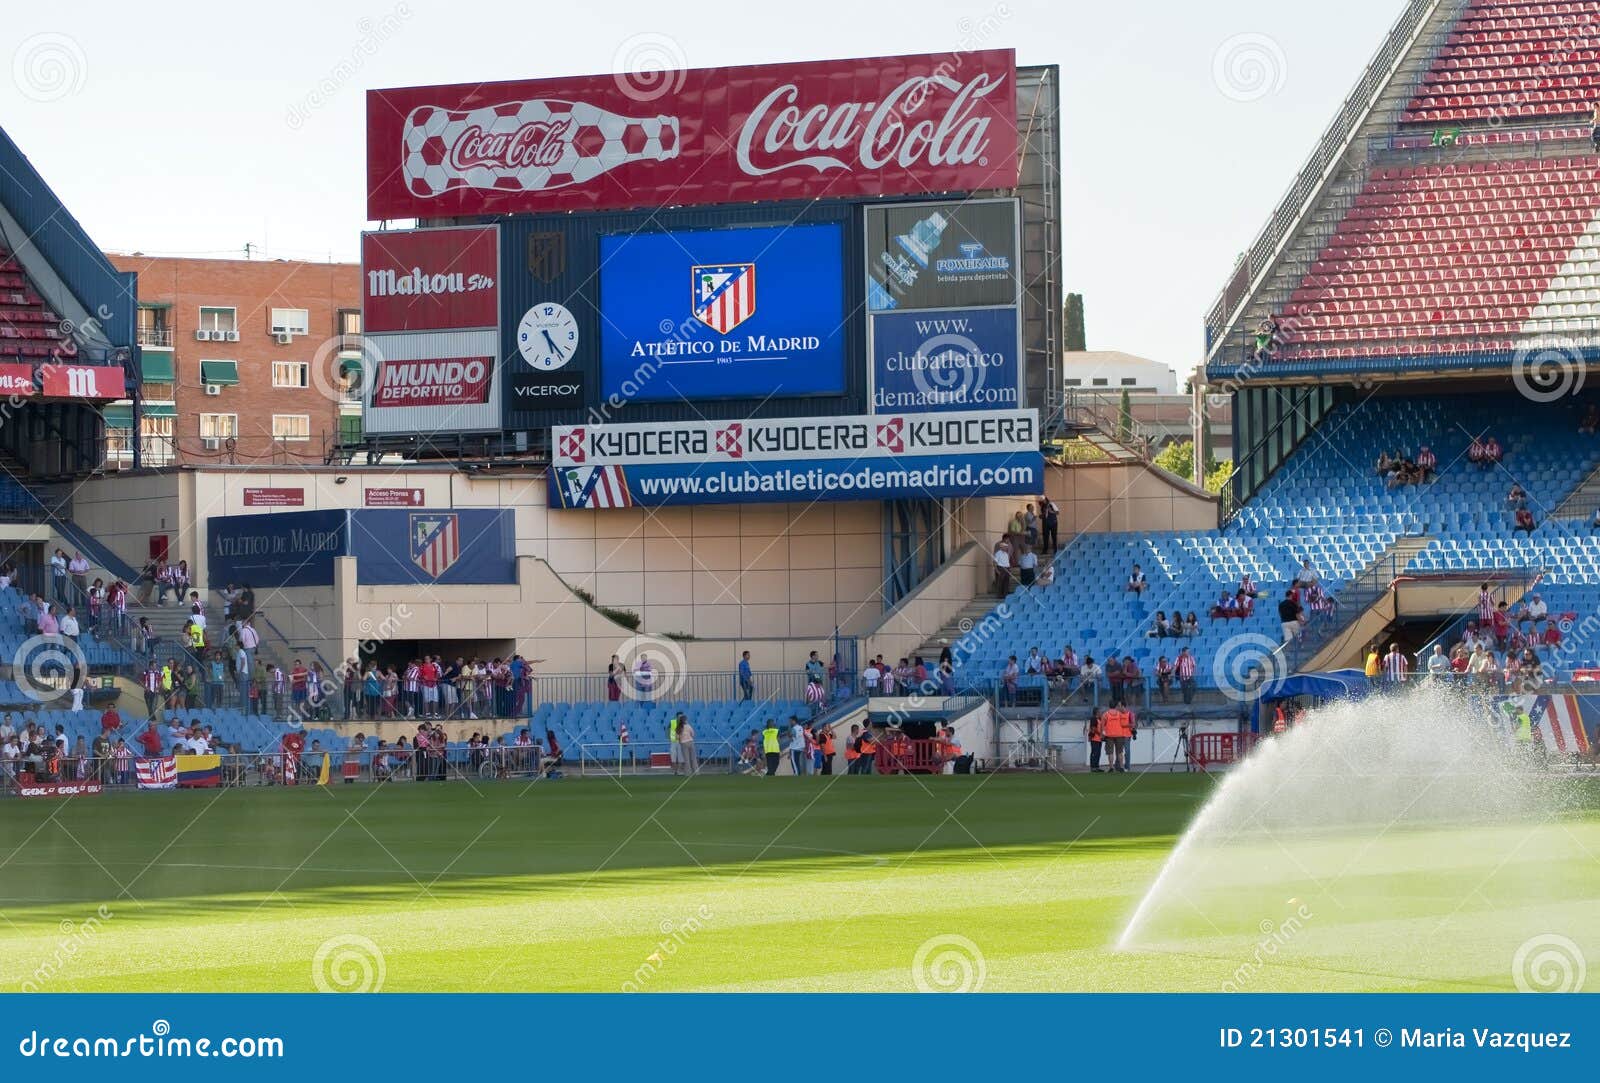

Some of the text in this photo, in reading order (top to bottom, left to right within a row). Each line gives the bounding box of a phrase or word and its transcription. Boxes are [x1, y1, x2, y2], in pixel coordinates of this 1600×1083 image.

[737, 72, 1008, 176] Coca-Cola
[451, 119, 572, 171] Coca-Cola
[368, 266, 465, 297] Mahou
[543, 306, 554, 316] 12
[521, 332, 528, 342] 9
[568, 331, 575, 340] 3
[915, 318, 973, 335] www.
[544, 357, 551, 366] 6
[886, 348, 1004, 372] clubatletico
[384, 361, 485, 387] MUNDO
[382, 384, 463, 399] DEPORTIVO
[514, 385, 580, 396] VICEROY
[873, 384, 1017, 408] demadrid.com
[590, 417, 1033, 458] KYOCERA KYOCERA KYOCERA
[640, 464, 1033, 495] www.clubatleticodemadrid.com
